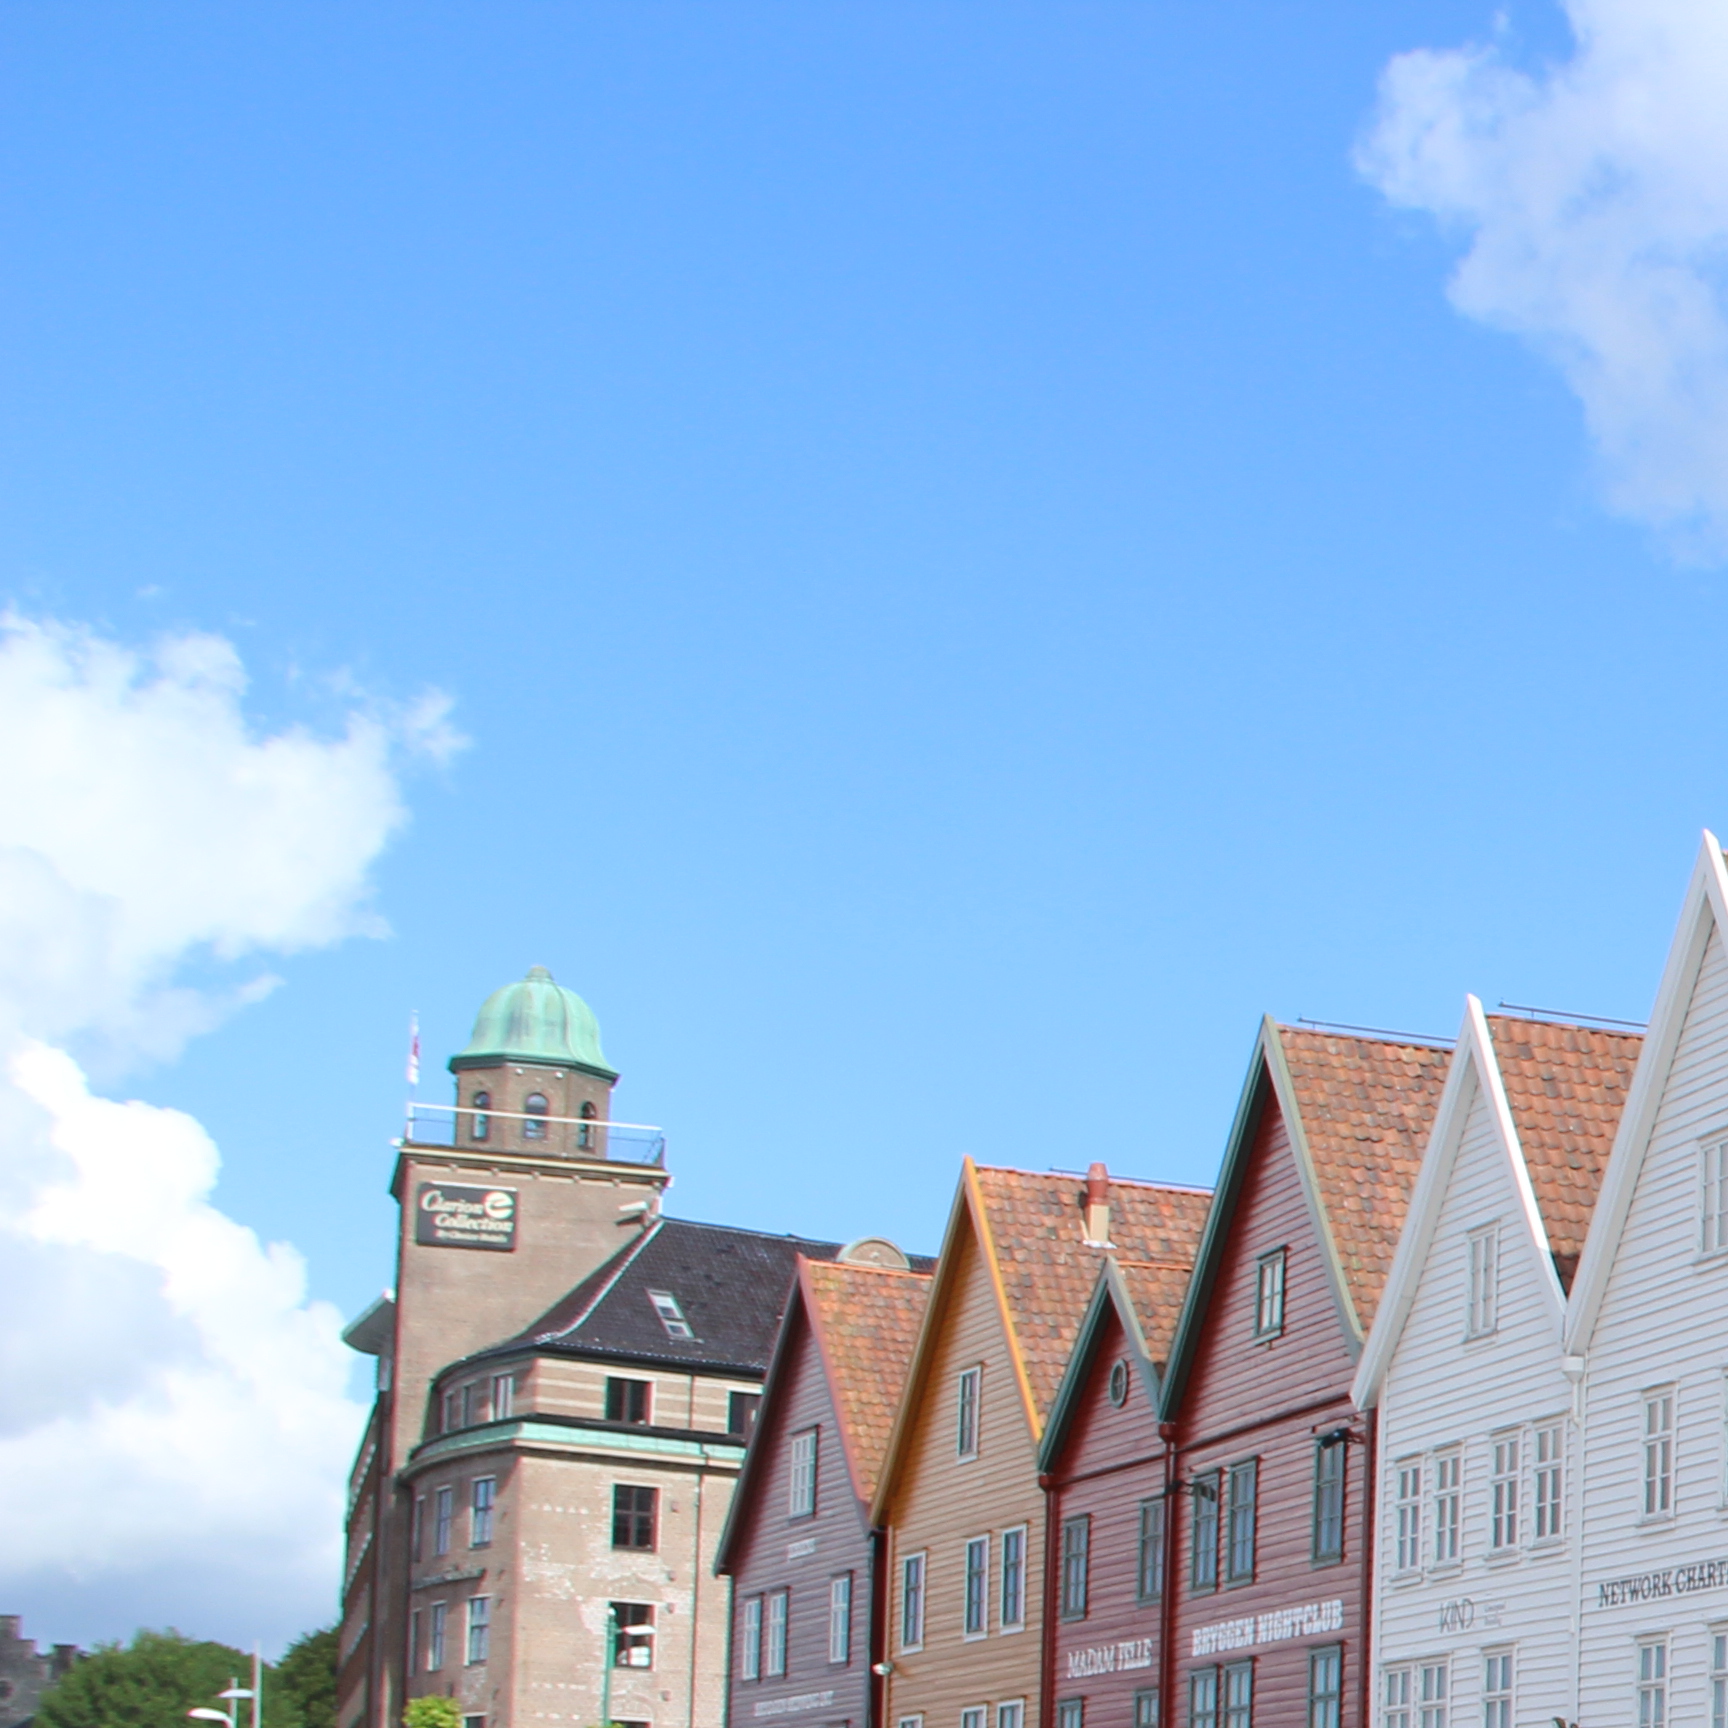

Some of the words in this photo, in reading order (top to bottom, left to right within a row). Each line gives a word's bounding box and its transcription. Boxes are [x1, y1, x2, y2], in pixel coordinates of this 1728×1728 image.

[421, 1189, 484, 1215] Clarion
[434, 1213, 514, 1233] Collection
[1598, 1570, 1673, 1607] NETWORK
[1192, 1616, 1255, 1657] BRYGGEN
[1257, 1599, 1343, 1645] NIGHTCLUB
[1066, 1645, 1116, 1679] MADAM
[1118, 1638, 1153, 1671] FELLE
